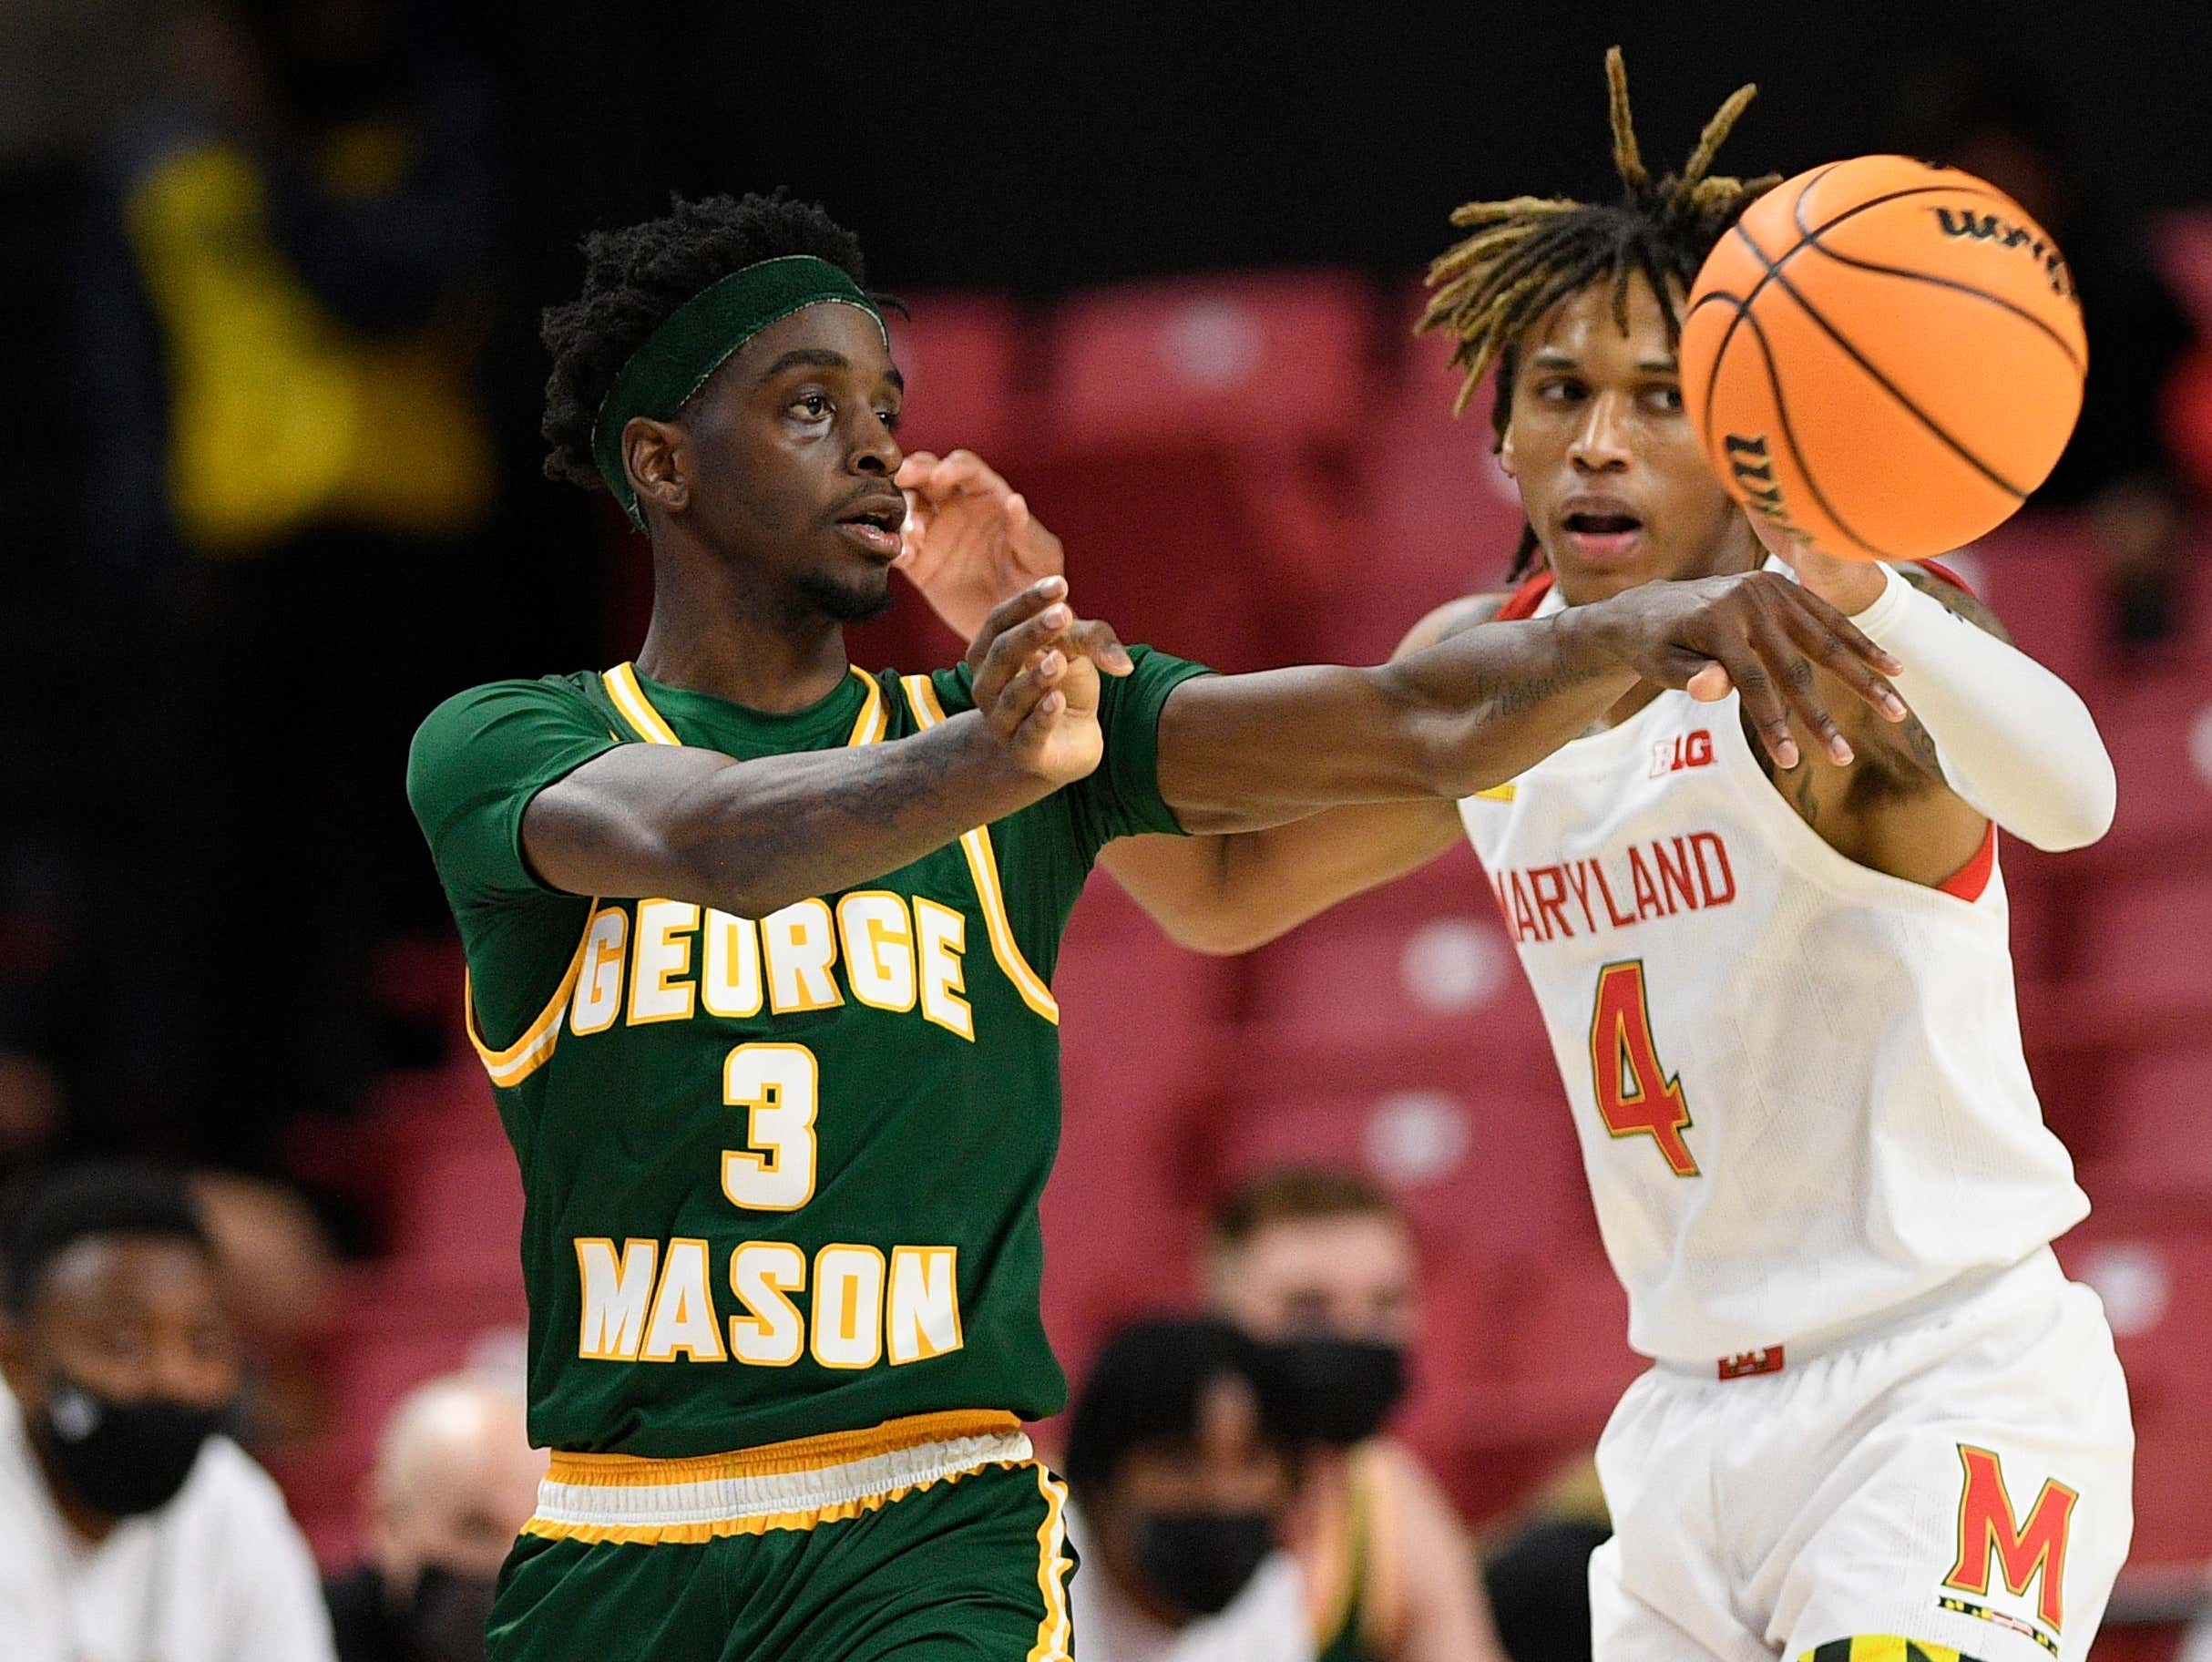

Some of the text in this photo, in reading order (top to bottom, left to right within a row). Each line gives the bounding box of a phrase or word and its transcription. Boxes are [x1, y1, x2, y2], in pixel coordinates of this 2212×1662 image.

[570, 891, 975, 1041] GEORGE
[722, 1042, 818, 1211] 3
[1590, 959, 1701, 1176] 4
[575, 1237, 964, 1369] MASON
[1941, 1442, 2079, 1633] M
